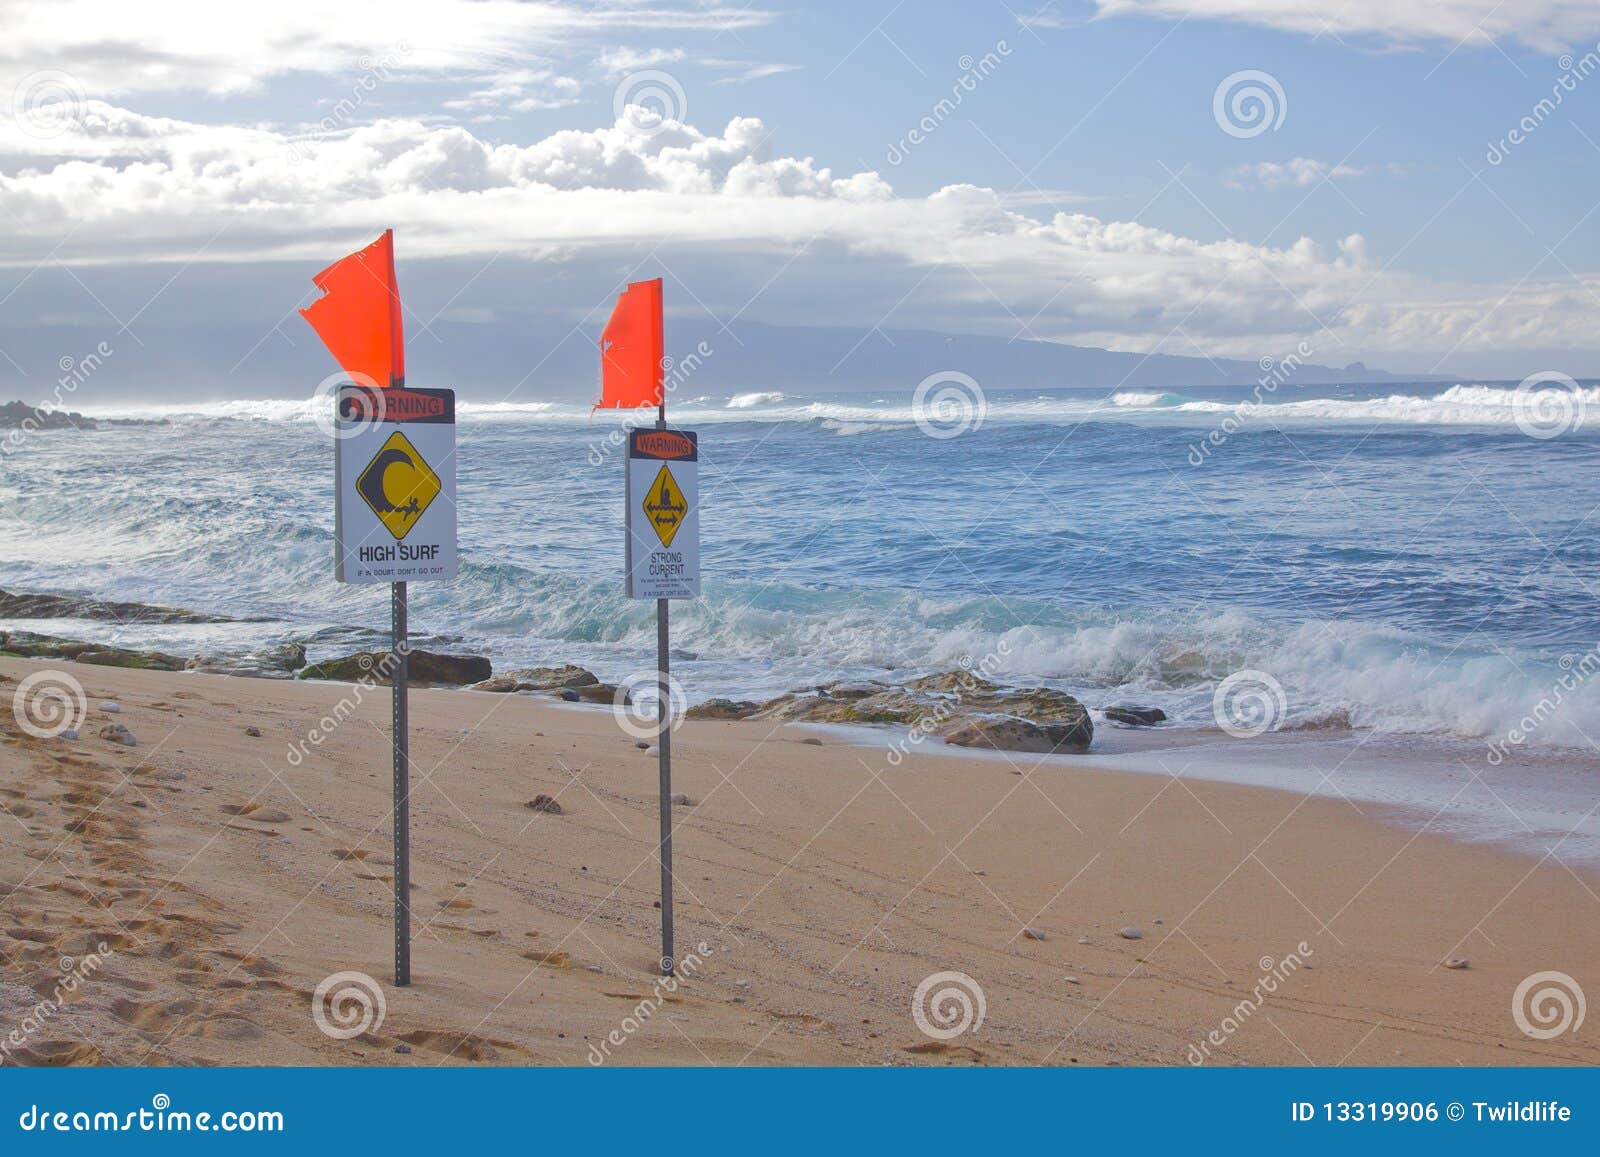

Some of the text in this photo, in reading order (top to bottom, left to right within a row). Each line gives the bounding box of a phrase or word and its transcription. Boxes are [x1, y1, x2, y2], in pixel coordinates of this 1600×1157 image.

[640, 436, 689, 454] WARNING
[360, 544, 440, 562] HIGH SURF
[651, 552, 682, 563] STRONG
[649, 563, 684, 575] CURRENT
